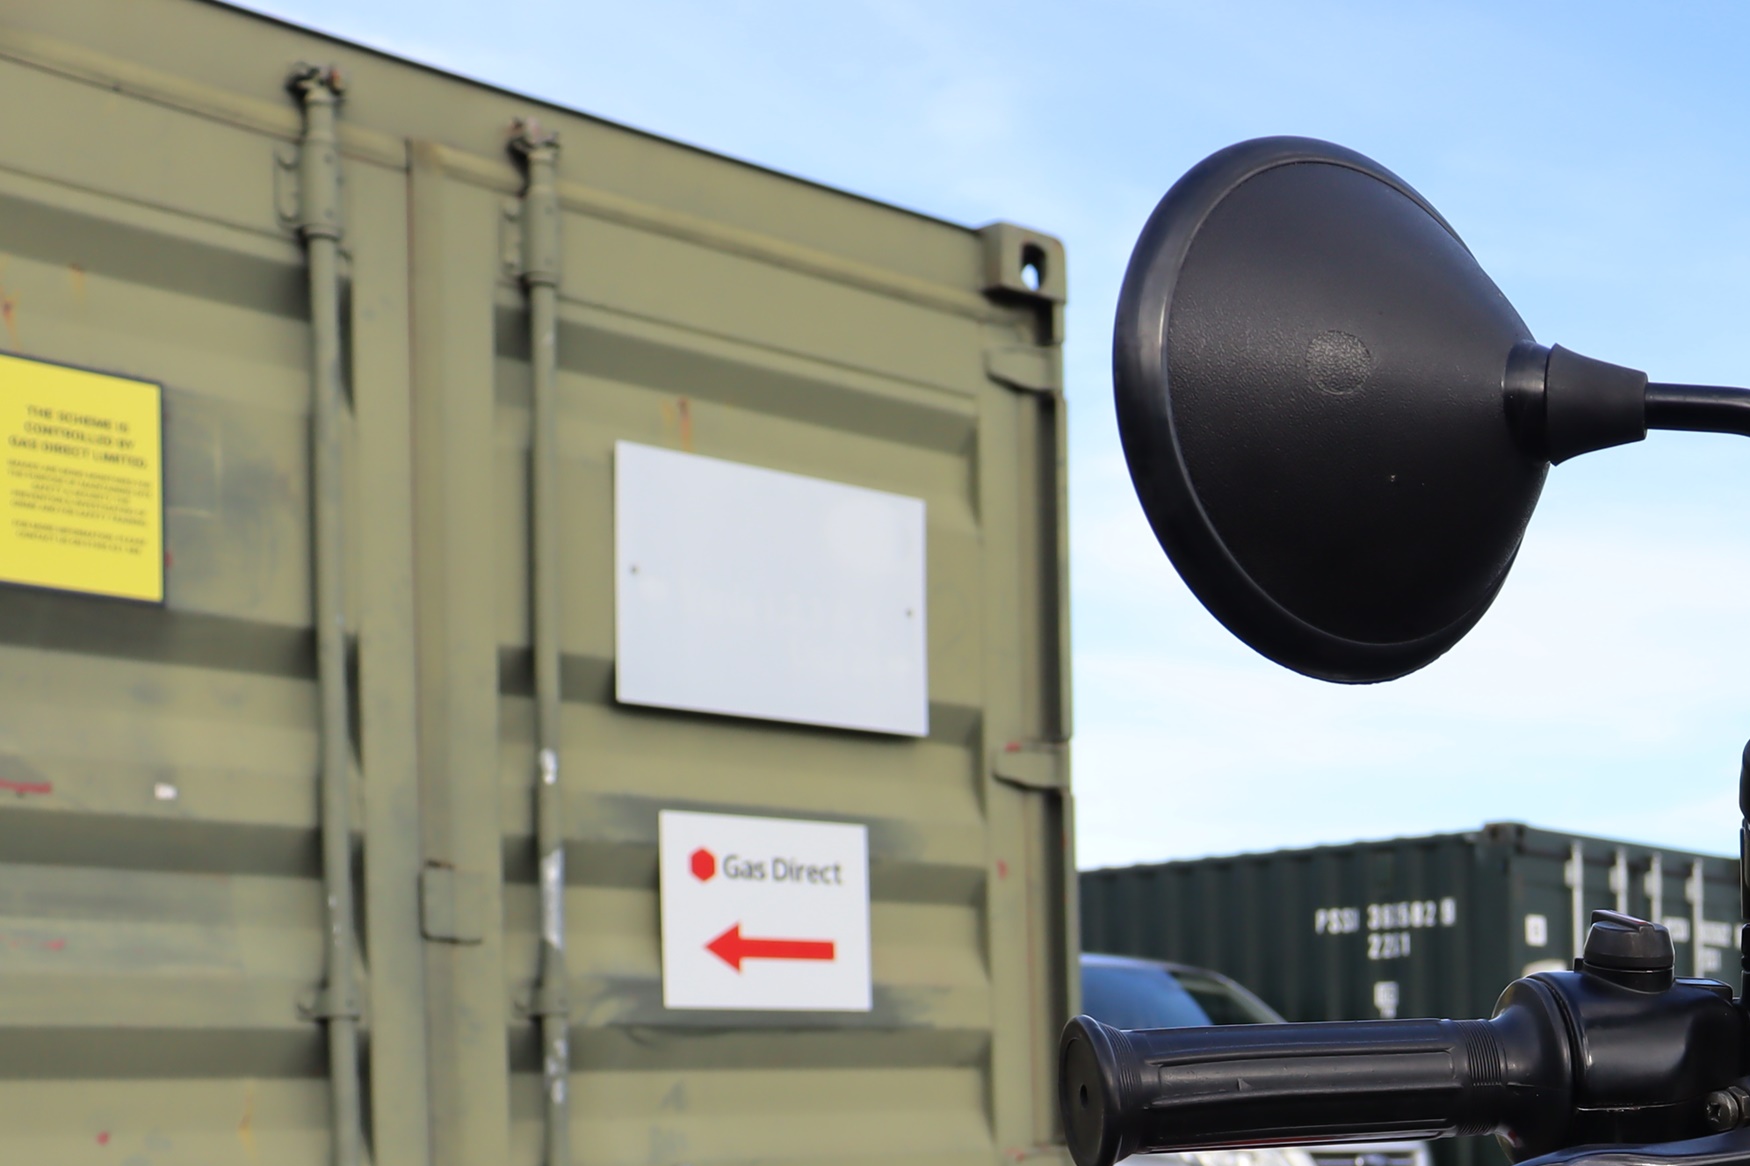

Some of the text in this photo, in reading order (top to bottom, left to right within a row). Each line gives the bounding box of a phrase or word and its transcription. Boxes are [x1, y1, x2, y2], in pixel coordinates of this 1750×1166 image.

[27, 404, 129, 433] THE SCHEME IS
[8, 435, 37, 450] GAS
[42, 440, 89, 458] DIRECT
[24, 421, 134, 450] CONTROLLED BY
[722, 854, 842, 885] Gas Direct
